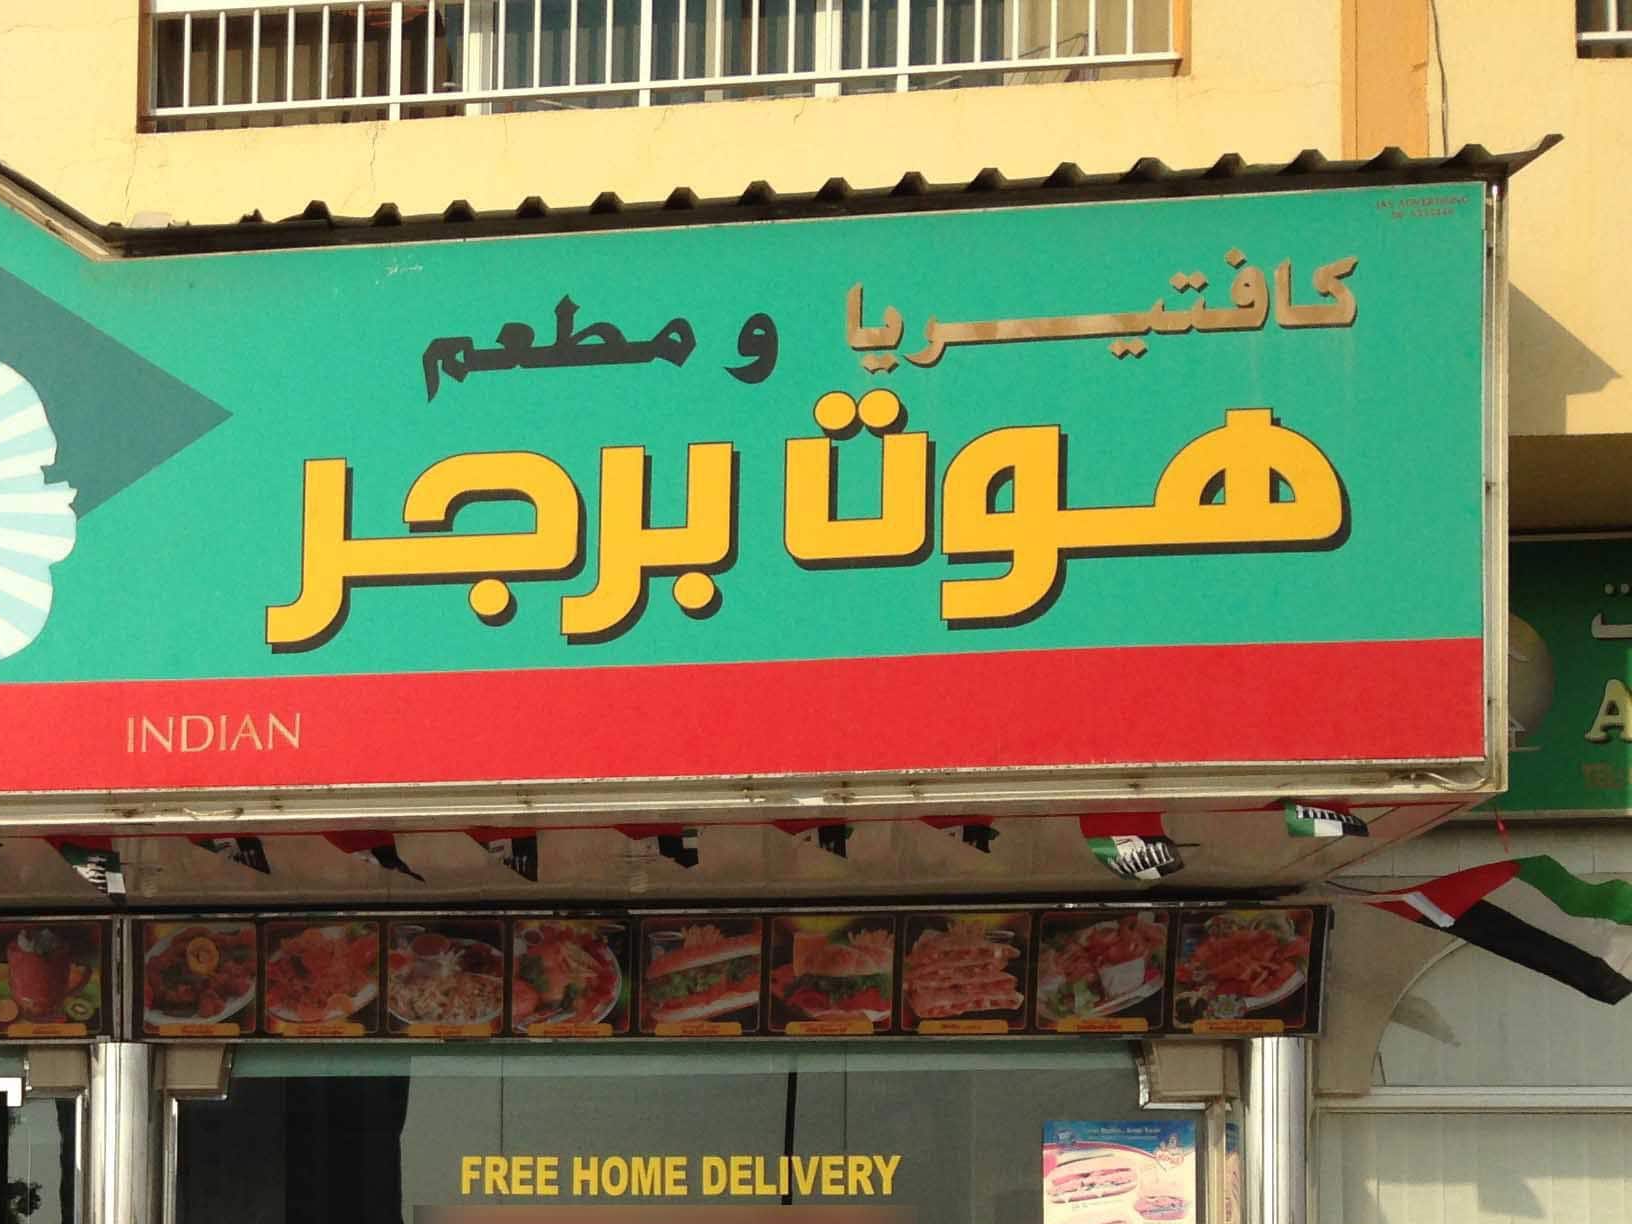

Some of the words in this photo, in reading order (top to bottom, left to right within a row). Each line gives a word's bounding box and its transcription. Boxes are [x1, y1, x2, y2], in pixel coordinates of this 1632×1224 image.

[422, 294, 698, 402] مطعم
[725, 310, 779, 383] و
[845, 250, 1360, 372] كافتيريا
[264, 439, 740, 653] برجر
[783, 387, 1351, 628] هوت
[126, 713, 302, 753] INDIAN
[460, 1155, 561, 1196] FREE
[572, 1155, 690, 1196] HOME
[702, 1154, 903, 1196] DELIVERY
